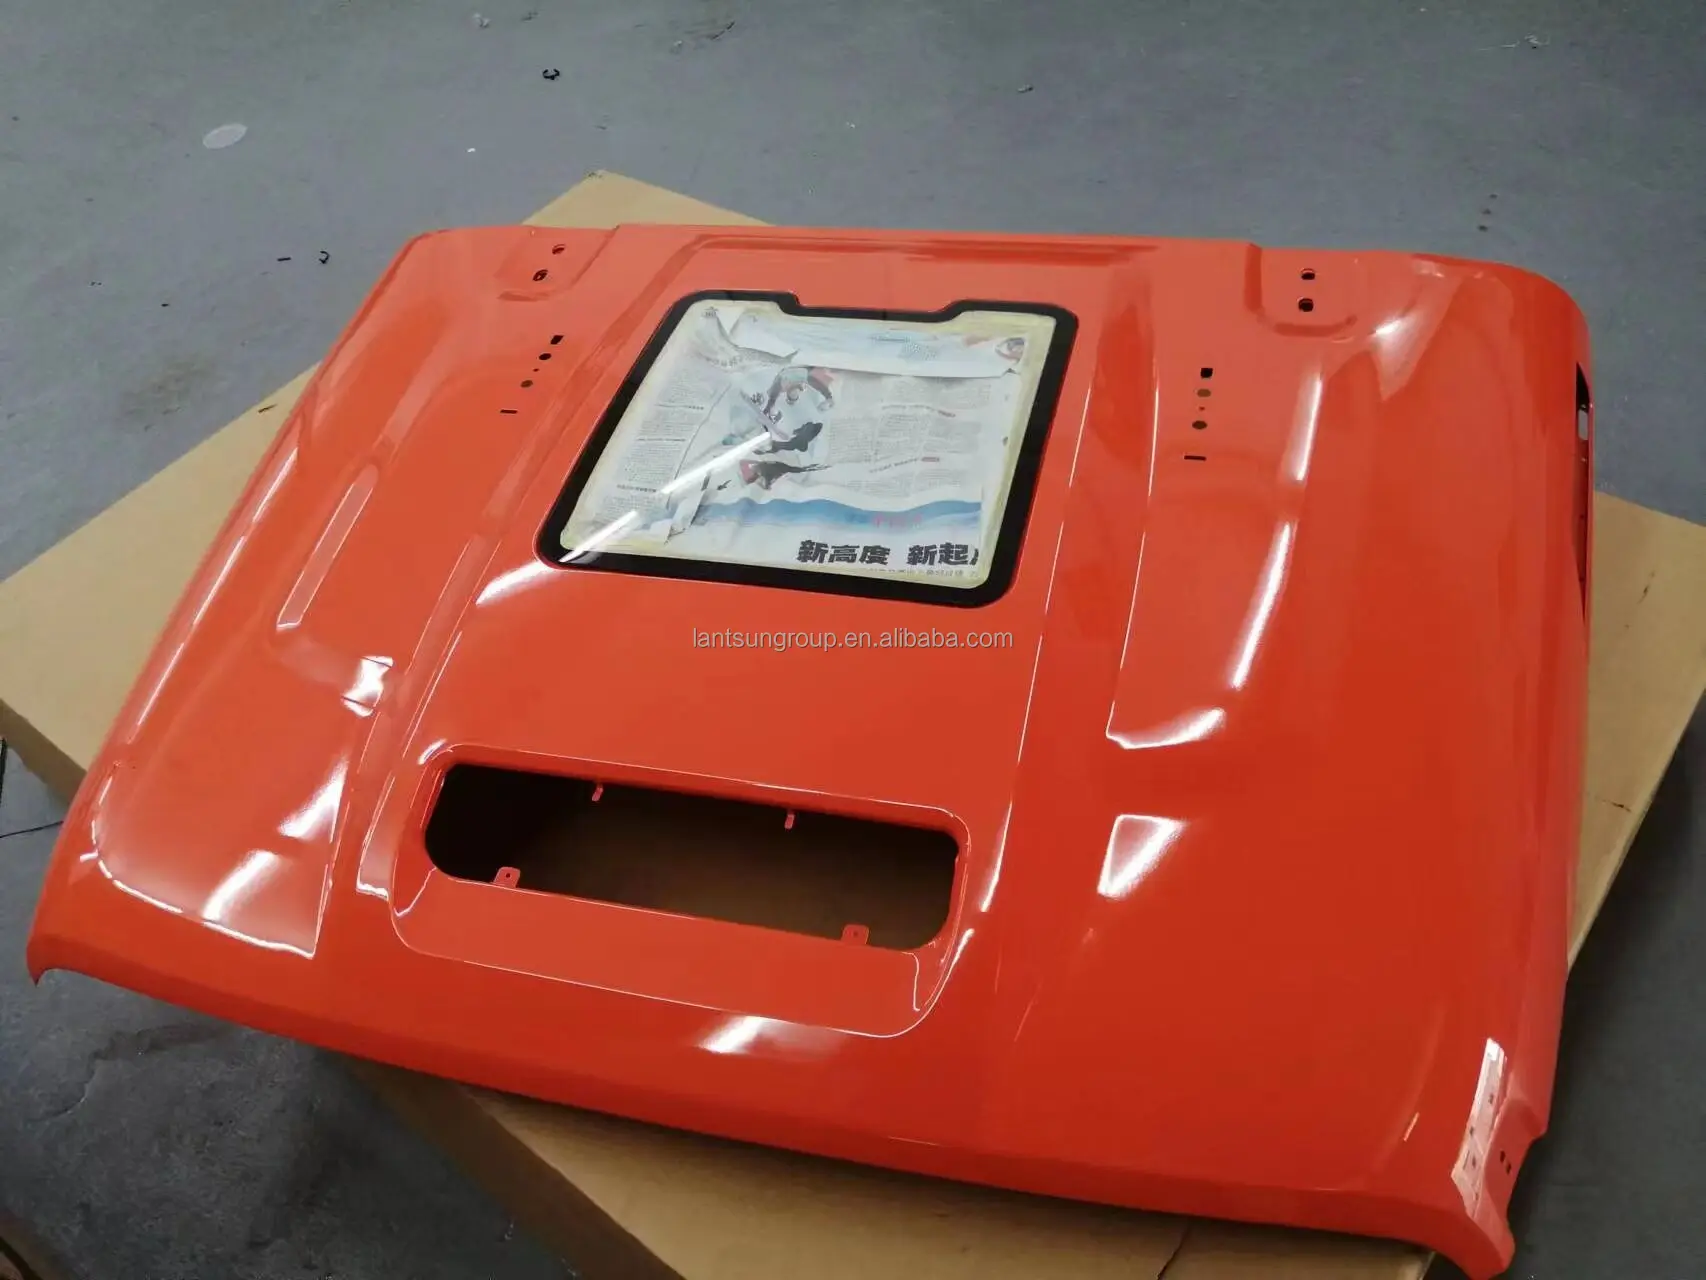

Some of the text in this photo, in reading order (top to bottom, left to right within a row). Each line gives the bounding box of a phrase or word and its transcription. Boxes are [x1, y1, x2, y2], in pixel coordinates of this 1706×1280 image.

[797, 540, 979, 566] 新高度 新起
